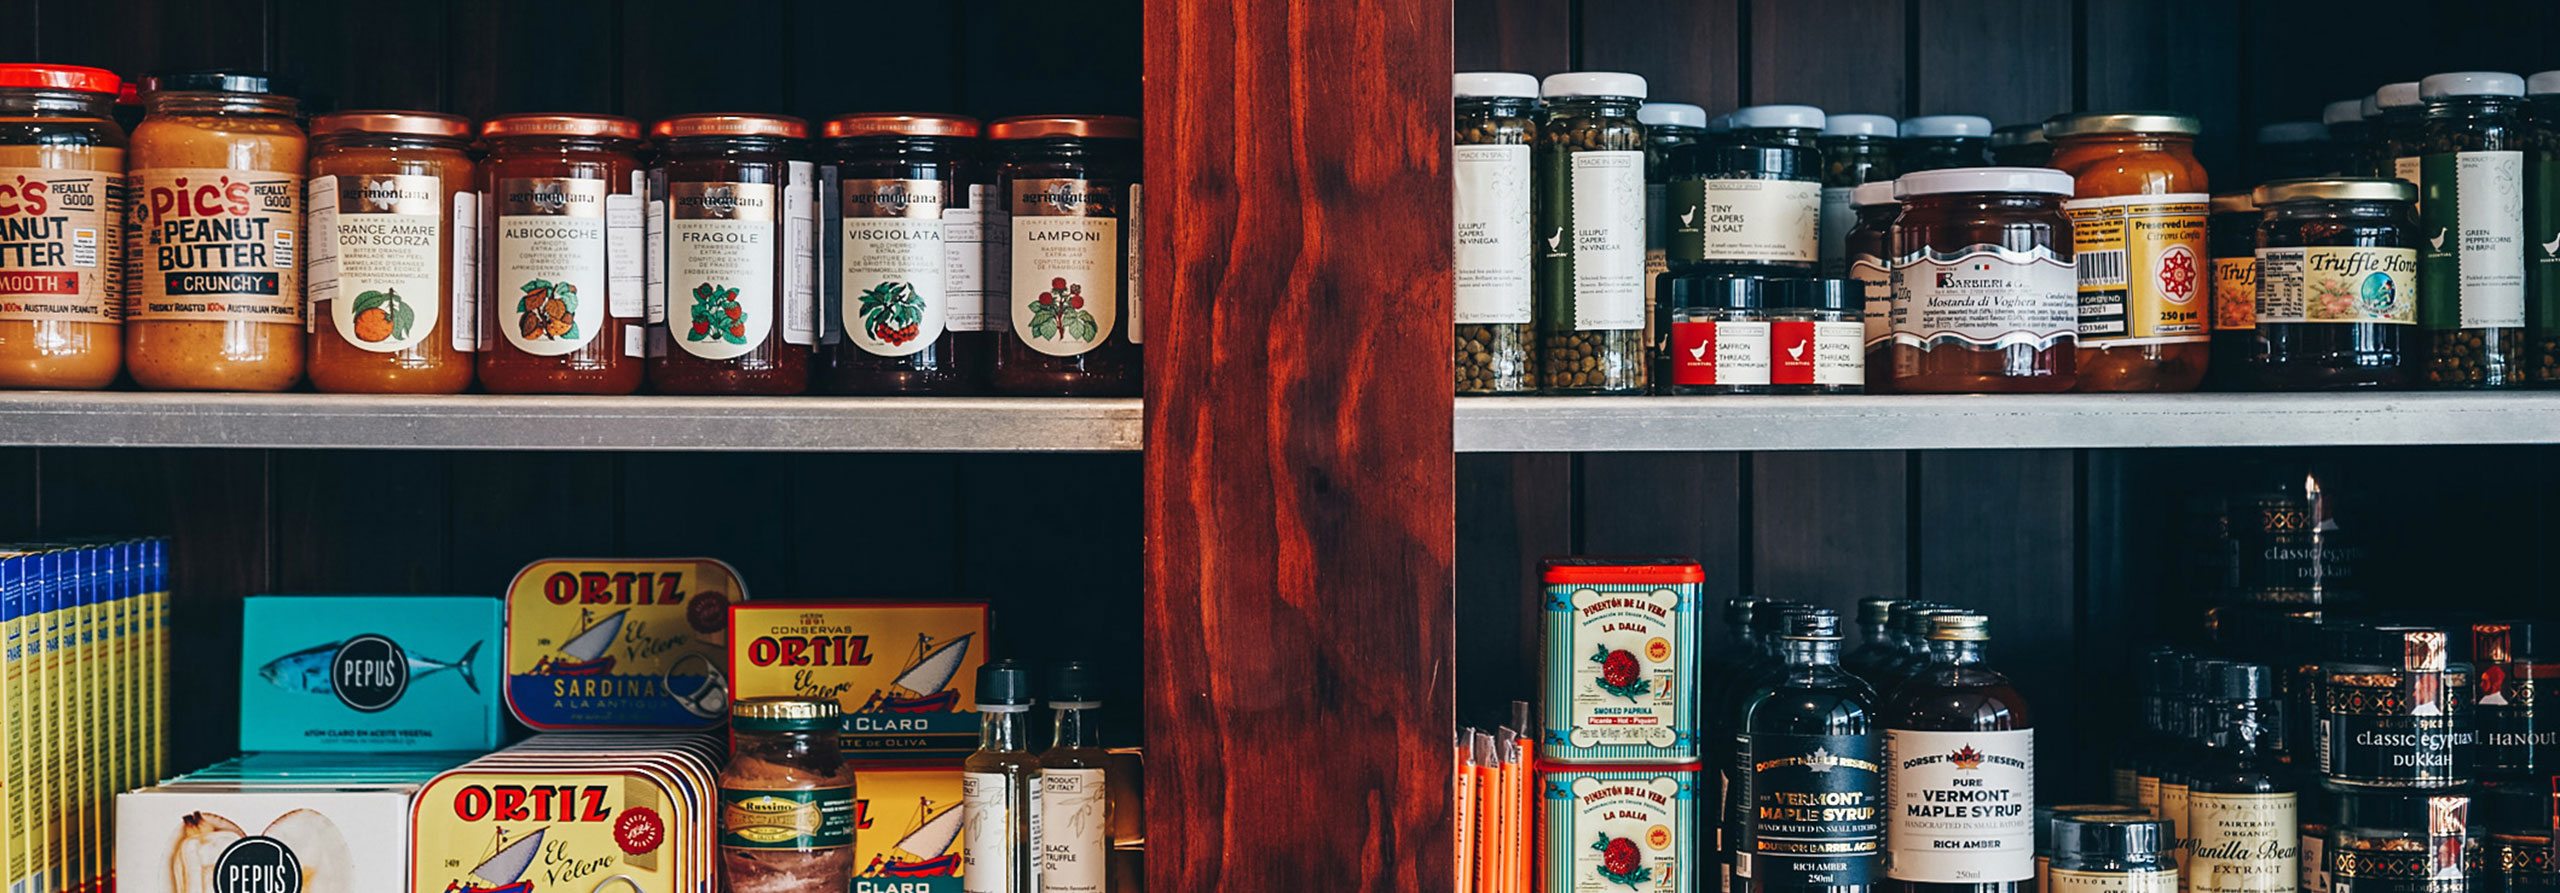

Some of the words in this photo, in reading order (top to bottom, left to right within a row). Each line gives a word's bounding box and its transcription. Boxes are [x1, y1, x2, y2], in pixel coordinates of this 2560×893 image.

[52, 184, 90, 194] REALLY
[254, 185, 288, 196] REALLY
[63, 195, 94, 206] GOOD
[264, 196, 291, 208] GOOD
[1711, 205, 1732, 213] TINY
[1710, 215, 1744, 223] CAPERS
[164, 218, 270, 243] PEANUT
[390, 226, 436, 236] AMARE
[1458, 222, 1486, 230] LILLIPUT
[1722, 224, 1743, 232] SALT
[2136, 221, 2181, 230] Preserved
[505, 228, 598, 239] ALBICOCCHE
[683, 232, 759, 243] FRAGOLE
[849, 230, 940, 240] VISCIOLATA
[1029, 231, 1100, 241] LAMPONI
[2147, 232, 2178, 241] Citrons
[340, 236, 367, 245] CON
[372, 236, 430, 246] SCORZA
[158, 243, 268, 271] BUTTER
[2310, 252, 2379, 277] Truffle
[184, 276, 264, 292] CRUNCHY
[4, 302, 22, 312] 100%
[24, 304, 69, 313] AUSTRALIAN
[70, 305, 98, 314] PEANUTS
[1927, 297, 1975, 307] Mostarda
[1978, 296, 1989, 306] di
[1994, 297, 2036, 308] Voghera
[175, 302, 205, 312] ROASTED
[227, 303, 269, 314] AUSTRALIAN
[271, 305, 294, 315] PEANUTS
[2161, 312, 2178, 320] 250
[2180, 313, 2184, 322] g
[2265, 546, 2316, 561] classic
[544, 571, 686, 606] ORTIZ
[1582, 597, 1622, 617] PIMENTÓN
[1624, 598, 1634, 607] DE
[1636, 600, 1645, 610] LA
[1648, 602, 1667, 618] VERA
[626, 620, 642, 643] El
[771, 626, 852, 634] CONSERVAS
[1603, 624, 1615, 633] LA
[1619, 622, 1646, 634] DALIA
[626, 634, 689, 662] Velero
[748, 635, 873, 667] ORTIZ
[345, 660, 395, 687] PEPUS
[794, 670, 813, 690] El
[554, 679, 670, 697] SARDINAS
[797, 681, 852, 698] elero
[554, 700, 562, 708] A
[570, 700, 589, 708] LA
[857, 719, 928, 731] CLARO
[886, 739, 927, 747] OLIVA
[2357, 730, 2416, 746] classic
[1756, 758, 1796, 773] DORSET
[1840, 757, 1878, 773] RESERVE
[1903, 754, 1943, 769] DORSET
[1946, 754, 1985, 763] MAPLE
[1987, 755, 2025, 770] RESERVE
[1953, 779, 1983, 787] PURE
[1584, 786, 1622, 805] PIMENTÓN
[1624, 786, 1634, 795] DE
[1636, 788, 1645, 798] LA
[1648, 791, 1666, 806] VERA
[1775, 792, 1863, 806] VERMONT
[1923, 790, 2010, 802] VERMONT
[454, 784, 612, 822] ORTIZ
[746, 802, 792, 811] Russino
[1603, 812, 1616, 821] LA
[1619, 811, 1647, 822] DALIA
[1760, 807, 1820, 821] MAPLE
[1823, 807, 1875, 821] SYRUP
[1908, 804, 1967, 818] MAPLE
[1972, 804, 2022, 818] SYRUP
[1905, 821, 1961, 829] HANDCRAFTED
[1973, 821, 1998, 829] SMALL
[1758, 841, 1808, 853] BOURBON
[1810, 841, 1853, 853] BARREL
[1854, 841, 1876, 852] AGED
[1933, 840, 1960, 849] RICH
[1963, 840, 2000, 849] AMBER
[2190, 838, 2252, 860] Vanilla
[546, 840, 567, 865] El
[1046, 854, 1076, 862] TRUFFLE
[542, 855, 616, 888] Velero
[1956, 870, 1981, 879] 250ml
[2213, 865, 2281, 874] EXTRACT
[230, 865, 286, 893] PEPUS
[1808, 874, 1833, 883] 250ml
[857, 882, 929, 893] CLARO
